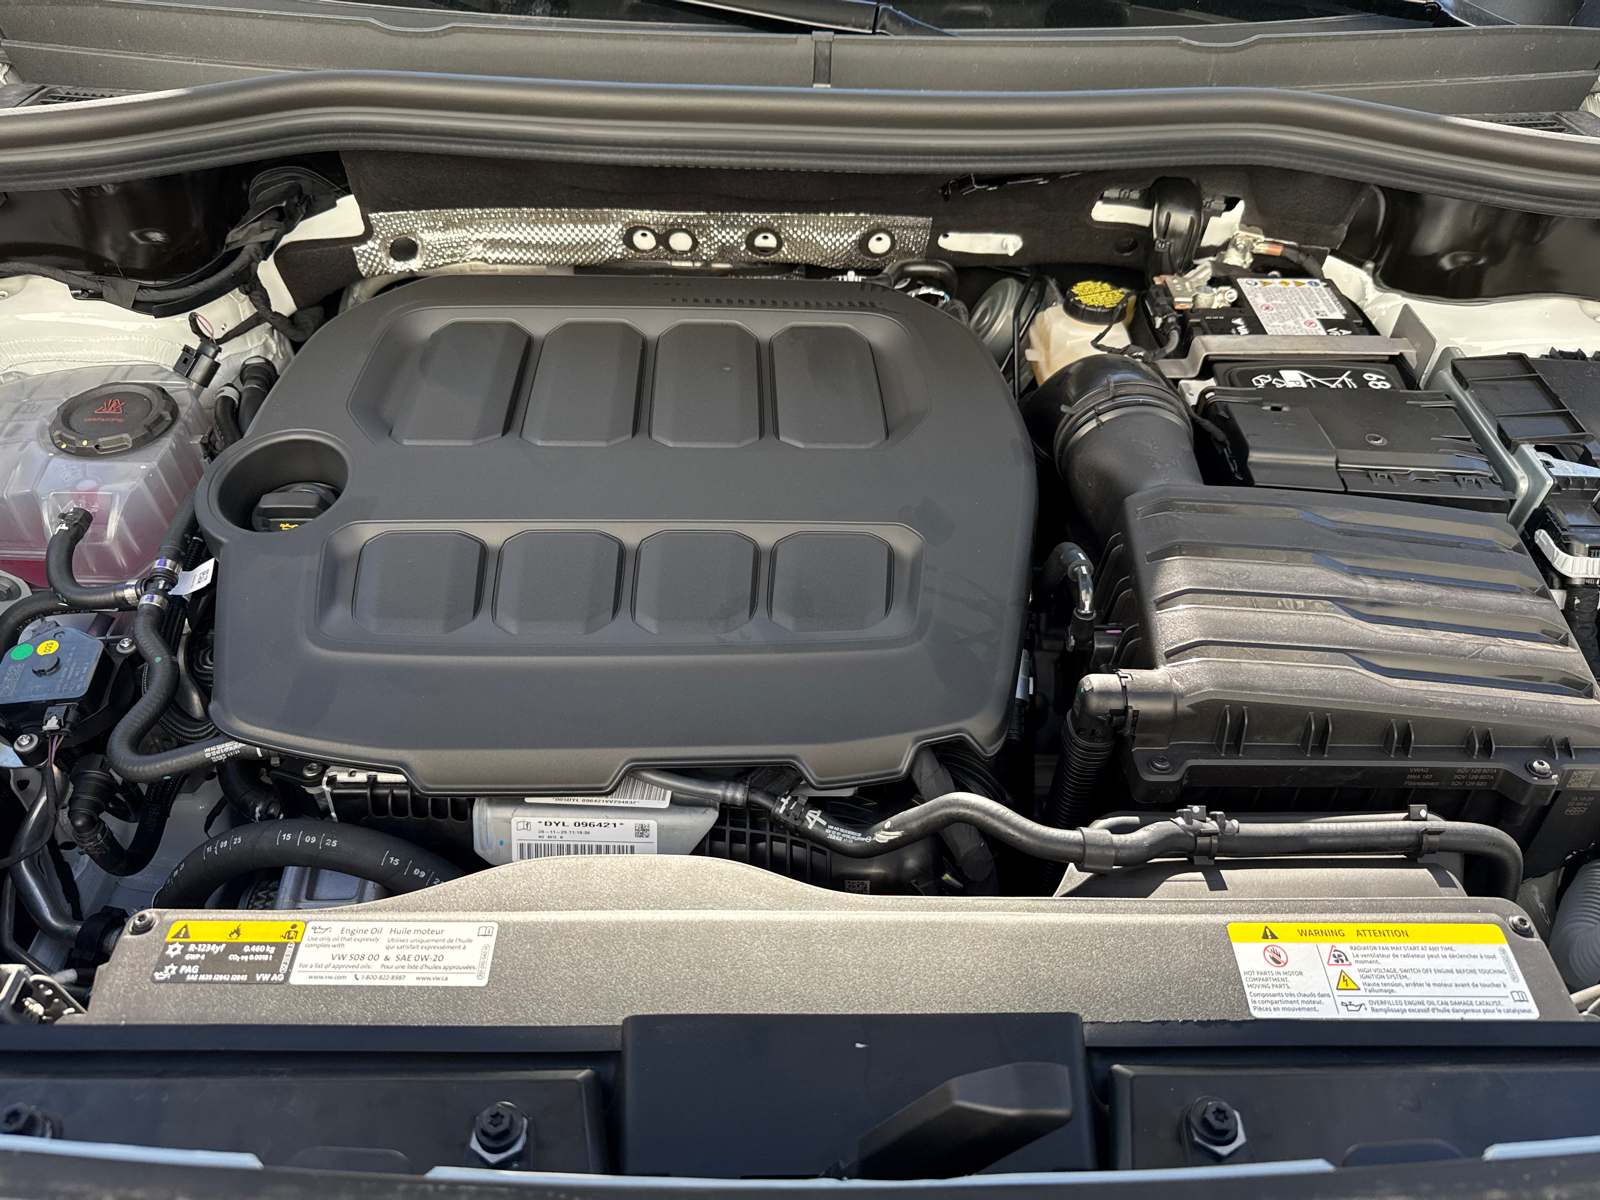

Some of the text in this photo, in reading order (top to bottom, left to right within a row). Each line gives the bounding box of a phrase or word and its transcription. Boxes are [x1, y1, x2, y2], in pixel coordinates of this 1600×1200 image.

[340, 927, 368, 936] Engine
[1297, 929, 1409, 937] WARNING ATTENTION
[266, 945, 276, 954] kg
[179, 965, 200, 974] PAG
